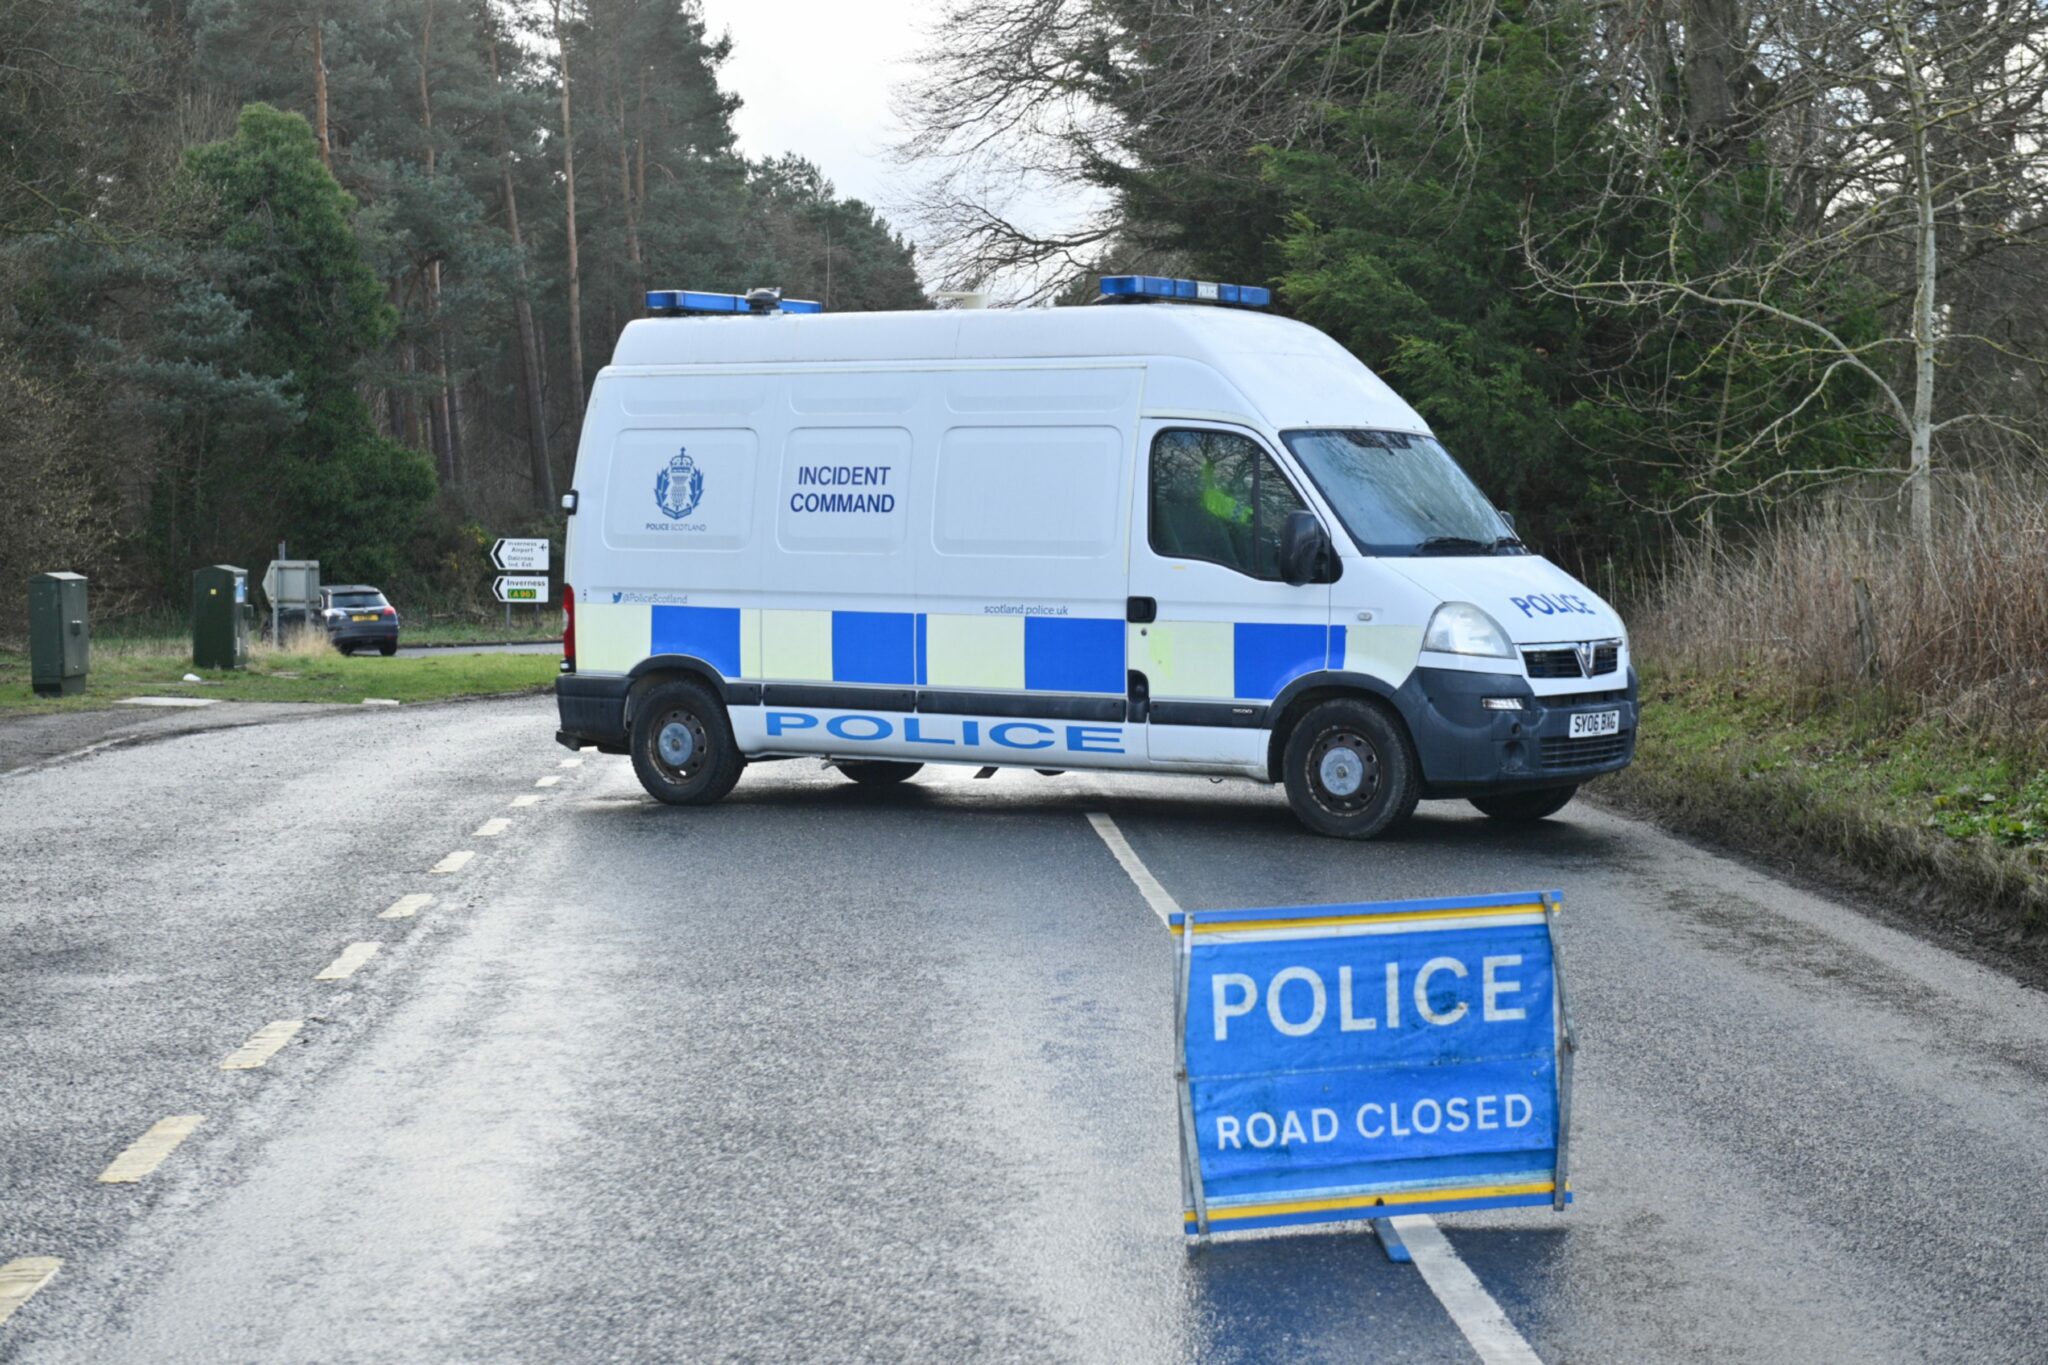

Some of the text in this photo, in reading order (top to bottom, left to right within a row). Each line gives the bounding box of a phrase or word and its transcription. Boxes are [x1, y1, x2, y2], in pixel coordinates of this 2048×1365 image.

[798, 466, 891, 485] INCIDENT
[790, 493, 895, 512] COMMAND
[646, 522, 707, 531] POLICE SCOTLAND
[623, 591, 688, 604] @PoliceScotland
[1510, 593, 1596, 618] POLICE
[984, 604, 1069, 616] scotland.police.uk
[765, 712, 1125, 753] POLICE
[1574, 714, 1600, 733] SY06
[1211, 954, 1527, 1041] POLICE
[1216, 1093, 1533, 1151] ROAD CLOSED
